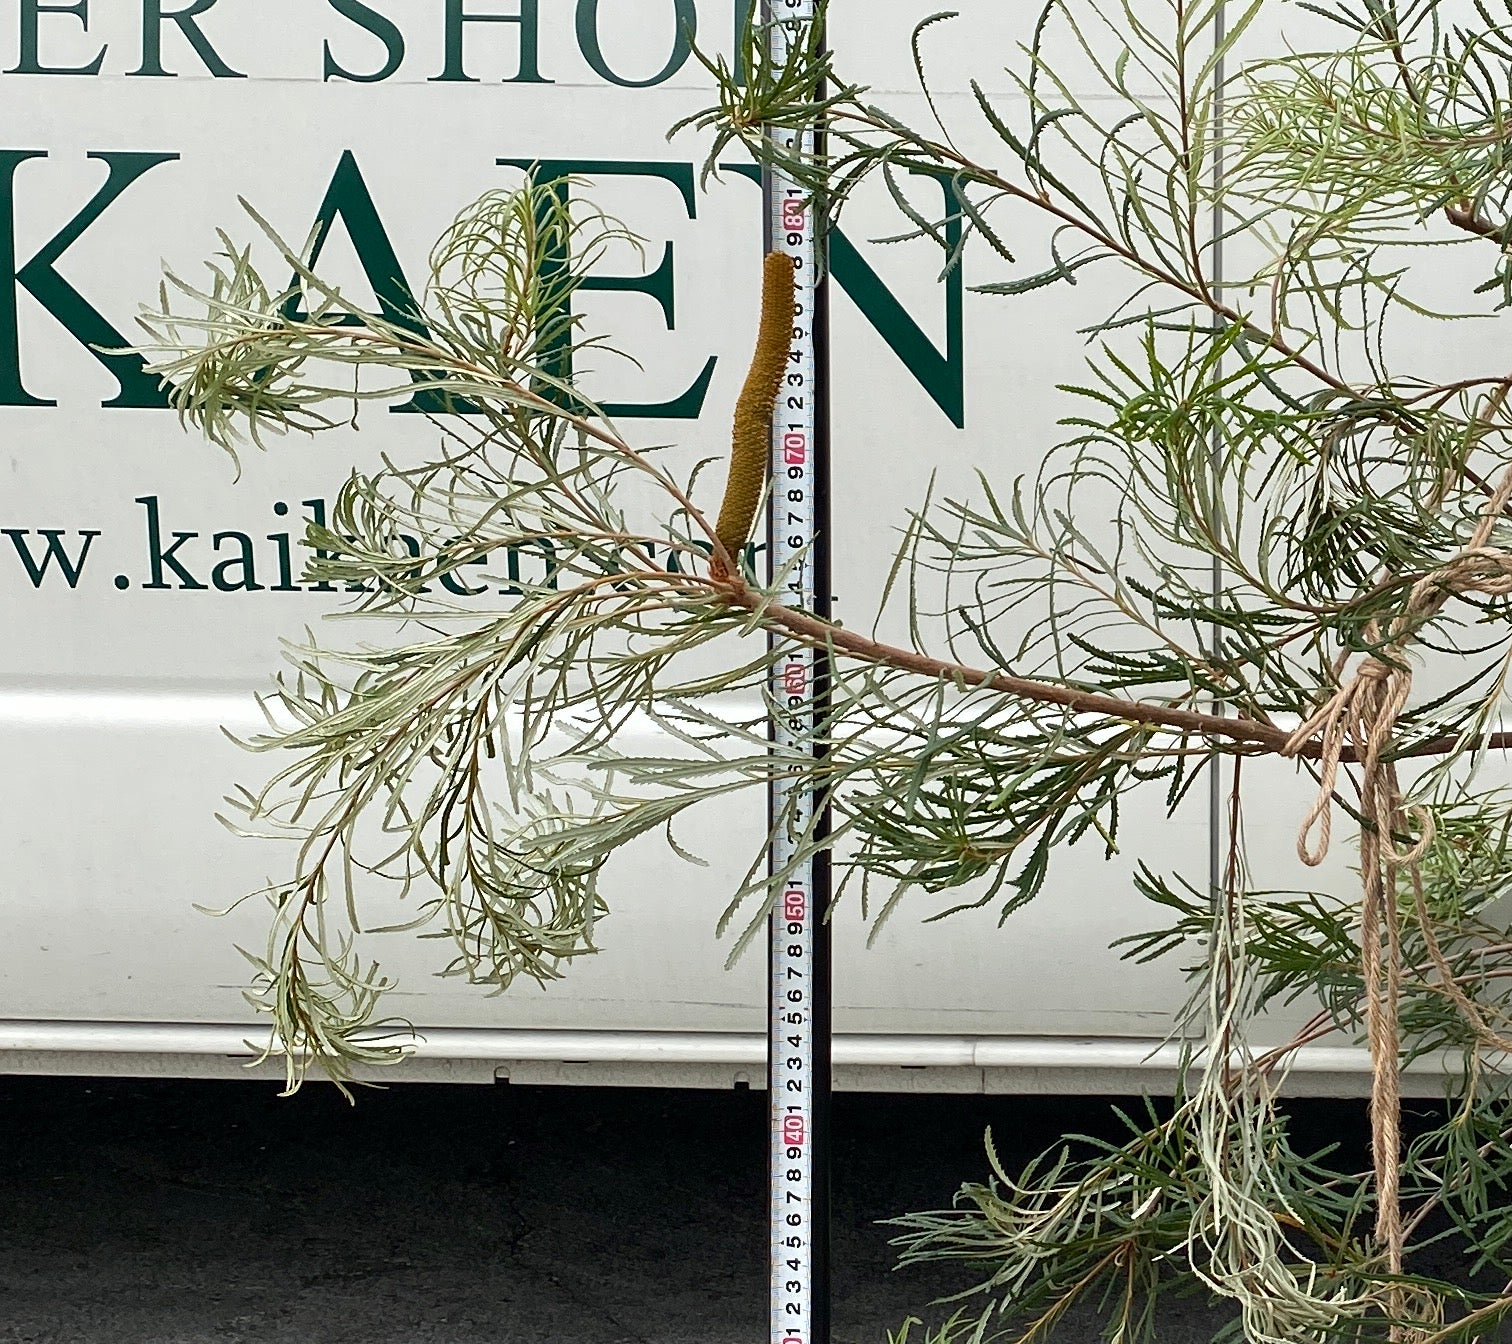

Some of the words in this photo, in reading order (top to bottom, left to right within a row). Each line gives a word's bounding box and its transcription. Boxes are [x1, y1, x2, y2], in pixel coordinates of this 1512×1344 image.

[786, 188, 802, 197] 1
[786, 232, 803, 247] 9
[789, 349, 803, 363] 4
[787, 373, 804, 387] 3
[787, 396, 804, 410] 2
[787, 423, 803, 432] 1
[786, 436, 804, 462] 70
[787, 465, 804, 479] 9
[787, 488, 804, 502] 8
[787, 511, 804, 525] 7
[787, 535, 804, 549] 6
[787, 653, 803, 662] 1
[786, 880, 802, 889] 1
[785, 893, 803, 919] 50
[786, 921, 802, 935] 9
[787, 944, 803, 958] 8
[787, 966, 803, 980] 7
[786, 989, 802, 1003] 6
[786, 1011, 802, 1025] 5
[787, 1034, 803, 1048] 4
[786, 1056, 802, 1070] 3
[786, 1079, 802, 1093] 2
[786, 1105, 802, 1114] 1
[785, 1118, 803, 1143] 40
[786, 1146, 802, 1160] 9
[786, 1168, 802, 1182] 8
[786, 1190, 802, 1204] 7
[785, 1213, 801, 1227] 6
[786, 1235, 802, 1249] 5
[786, 1257, 802, 1271] 4
[785, 1280, 801, 1294] 3
[785, 1302, 801, 1316] 2
[785, 1328, 801, 1337] 1
